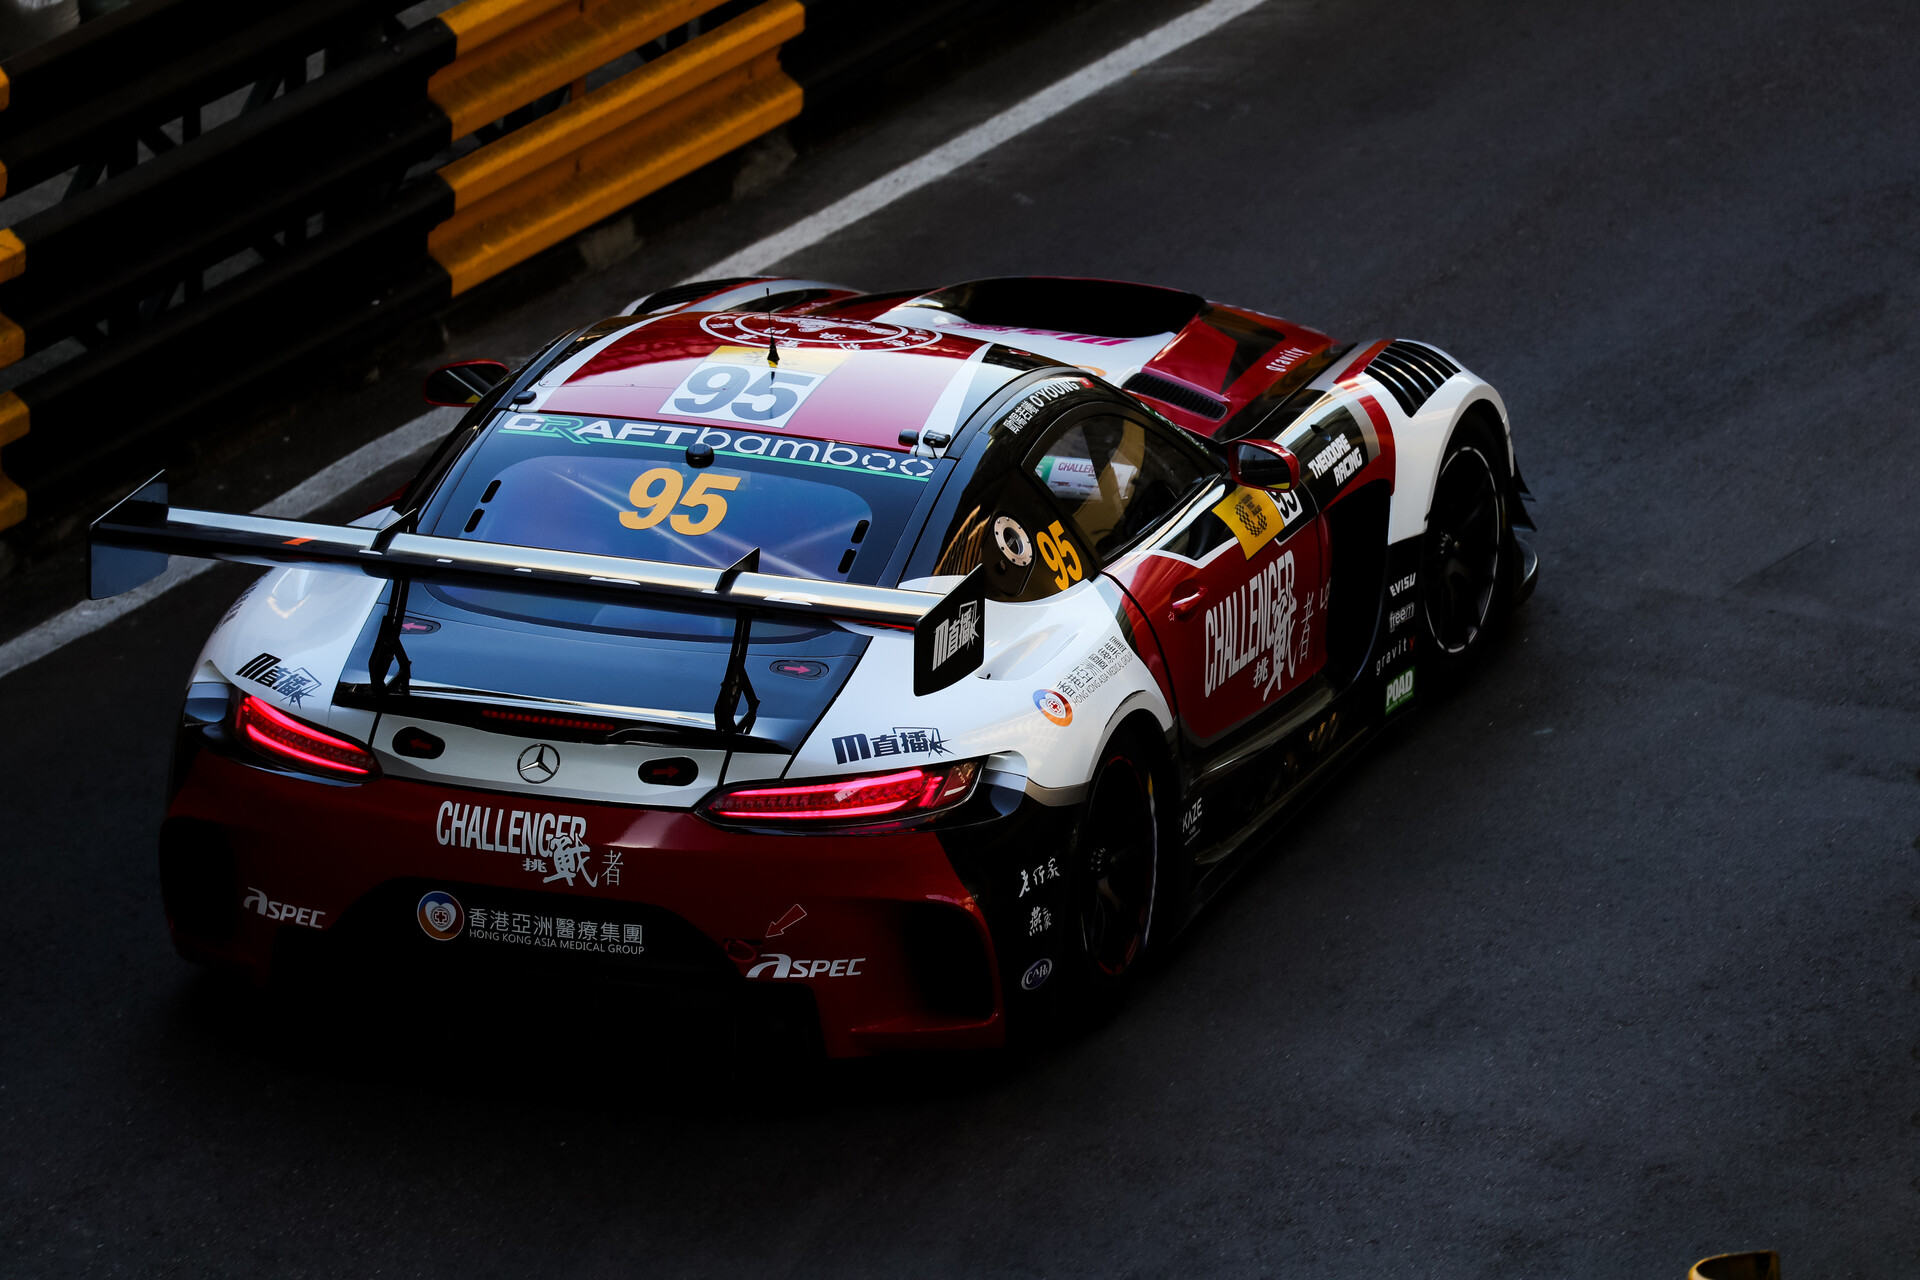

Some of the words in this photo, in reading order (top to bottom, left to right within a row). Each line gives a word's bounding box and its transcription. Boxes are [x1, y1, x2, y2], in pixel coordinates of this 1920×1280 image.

[674, 365, 816, 421] 95
[1029, 379, 1080, 408] O'YOUNG
[1308, 432, 1351, 480] THEODORE
[1333, 447, 1363, 487] RACING
[619, 467, 742, 536] 95
[1036, 519, 1083, 591] 95
[1389, 571, 1416, 597] EVISU
[1376, 635, 1415, 676] gravity
[1386, 669, 1413, 707] POAD
[435, 800, 587, 858] CHALLENGER
[1181, 797, 1203, 833] KAZE
[468, 907, 643, 946] 香港亞洲醫療集團
[469, 928, 500, 942] HONG
[502, 932, 532, 946] KONG
[533, 936, 557, 949] ASIA
[559, 940, 606, 953] MEDICAL
[607, 943, 645, 956] GROUP
